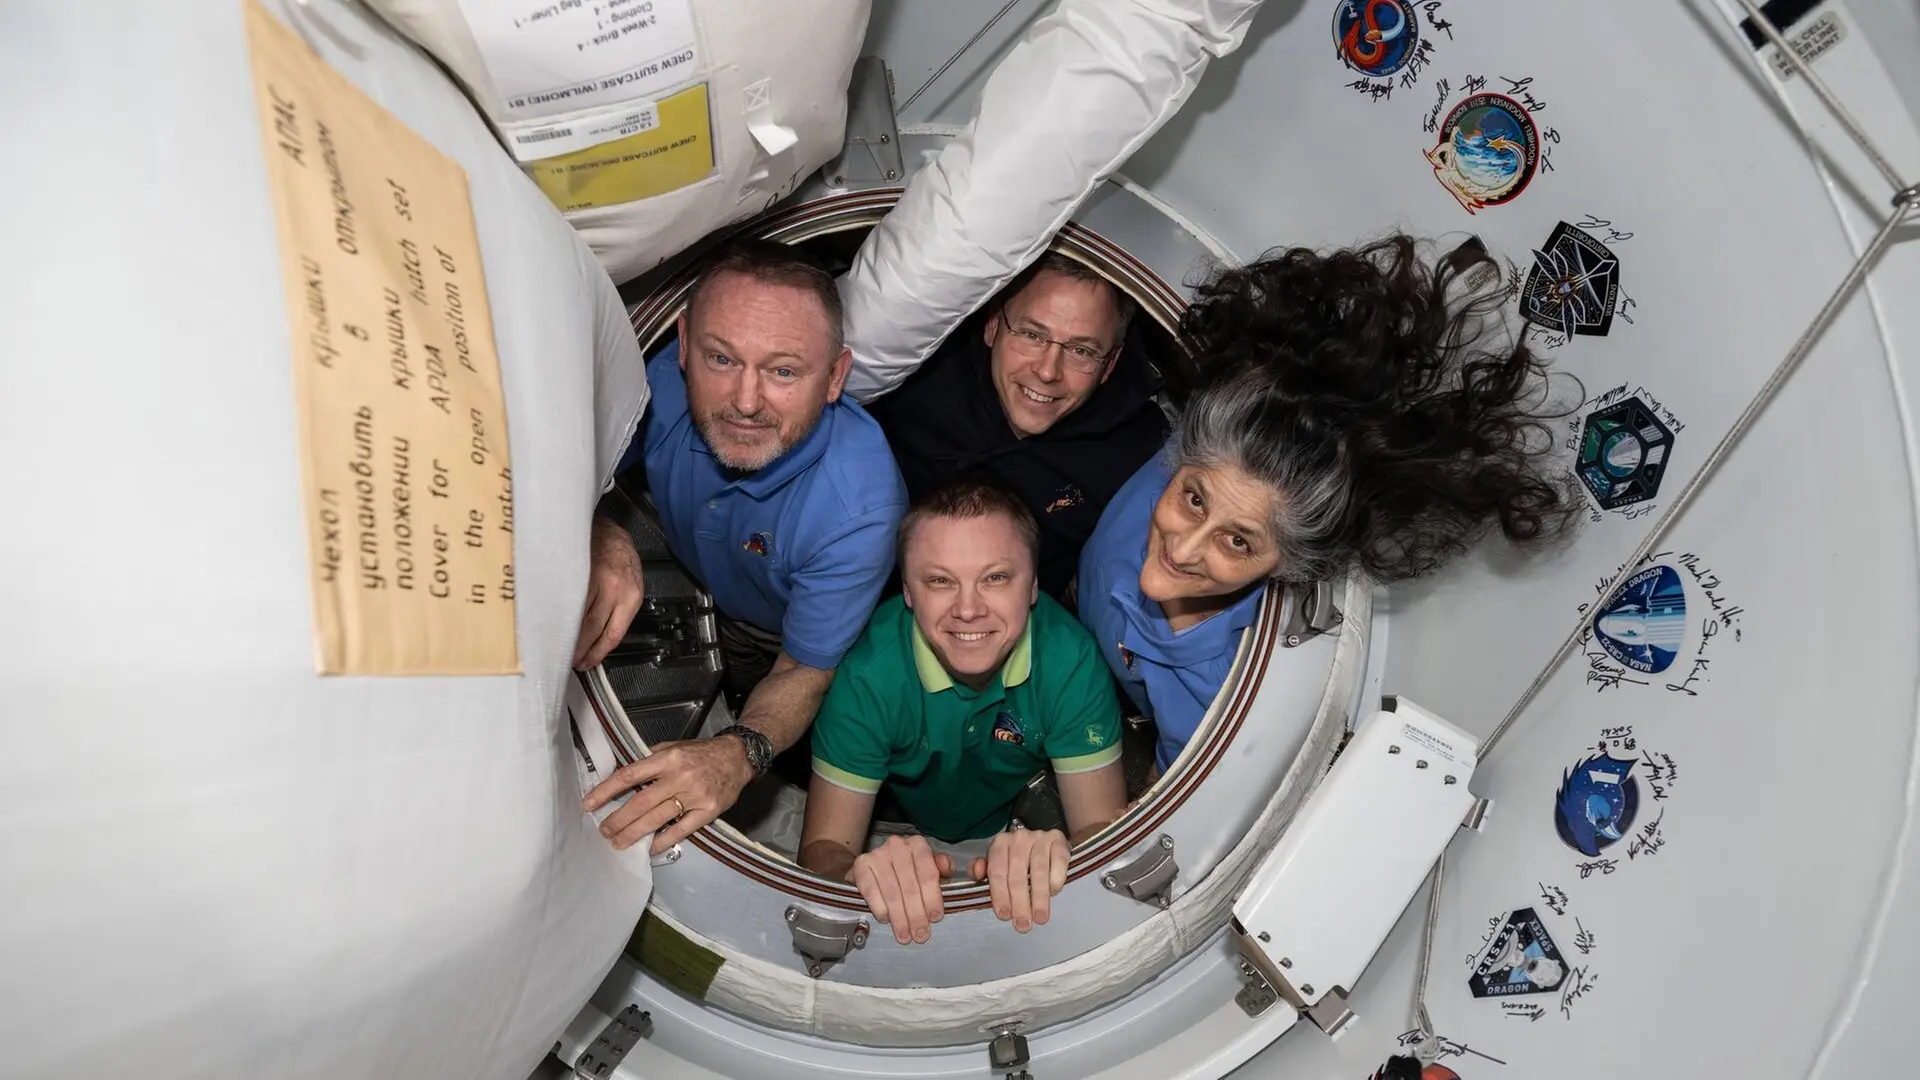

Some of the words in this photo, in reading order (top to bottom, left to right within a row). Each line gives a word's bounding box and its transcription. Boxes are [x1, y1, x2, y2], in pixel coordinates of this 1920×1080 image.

[531, 5, 559, 22] Liner
[611, 2, 653, 22] Clothing
[621, 15, 657, 35] 2-Week
[1402, 1, 1417, 33] BARRATT
[593, 29, 620, 46] Brick
[1802, 20, 1829, 40] CELL
[1813, 23, 1837, 44] LINE
[577, 43, 584, 52] 4
[661, 50, 694, 71] CREW
[1397, 37, 1416, 67] DOMINICK
[600, 62, 659, 90] SUITCASE
[509, 98, 525, 109] B1
[528, 83, 598, 106] (WILMORE)
[1445, 105, 1468, 133] БОРИСОВ
[1490, 97, 1526, 123] MOGENSEN
[268, 85, 306, 167] АПАС
[620, 124, 638, 135] CTB
[622, 144, 669, 163] SUITCASE
[671, 135, 697, 149] CREW
[1523, 124, 1536, 166] MOGHBELI
[317, 120, 359, 255] открытом
[386, 178, 412, 222] set
[1564, 225, 1611, 258] CRISTOFORETTI
[398, 239, 429, 305] hatch
[434, 246, 456, 273] of
[1524, 275, 1535, 297] HINES
[1605, 283, 1617, 317] WATKINS
[301, 255, 342, 369] крышки
[383, 287, 414, 390] крышки
[445, 282, 478, 374] position
[424, 344, 452, 415] APDA
[1602, 405, 1621, 415] NASA
[470, 407, 492, 465] open
[427, 459, 449, 498] for
[349, 405, 387, 590] установить
[392, 436, 415, 590] положении
[320, 488, 342, 583] Чехол
[464, 508, 485, 548] the
[429, 524, 450, 599] Cover
[466, 583, 486, 604] in
[498, 564, 516, 602] the
[1603, 586, 1629, 611] SPACEX
[1628, 567, 1663, 589] DRAGON
[1601, 636, 1624, 660] CRS-22
[1629, 658, 1653, 672] NASA
[1529, 919, 1554, 952] SPACEX
[1487, 984, 1529, 995] DRAGON
